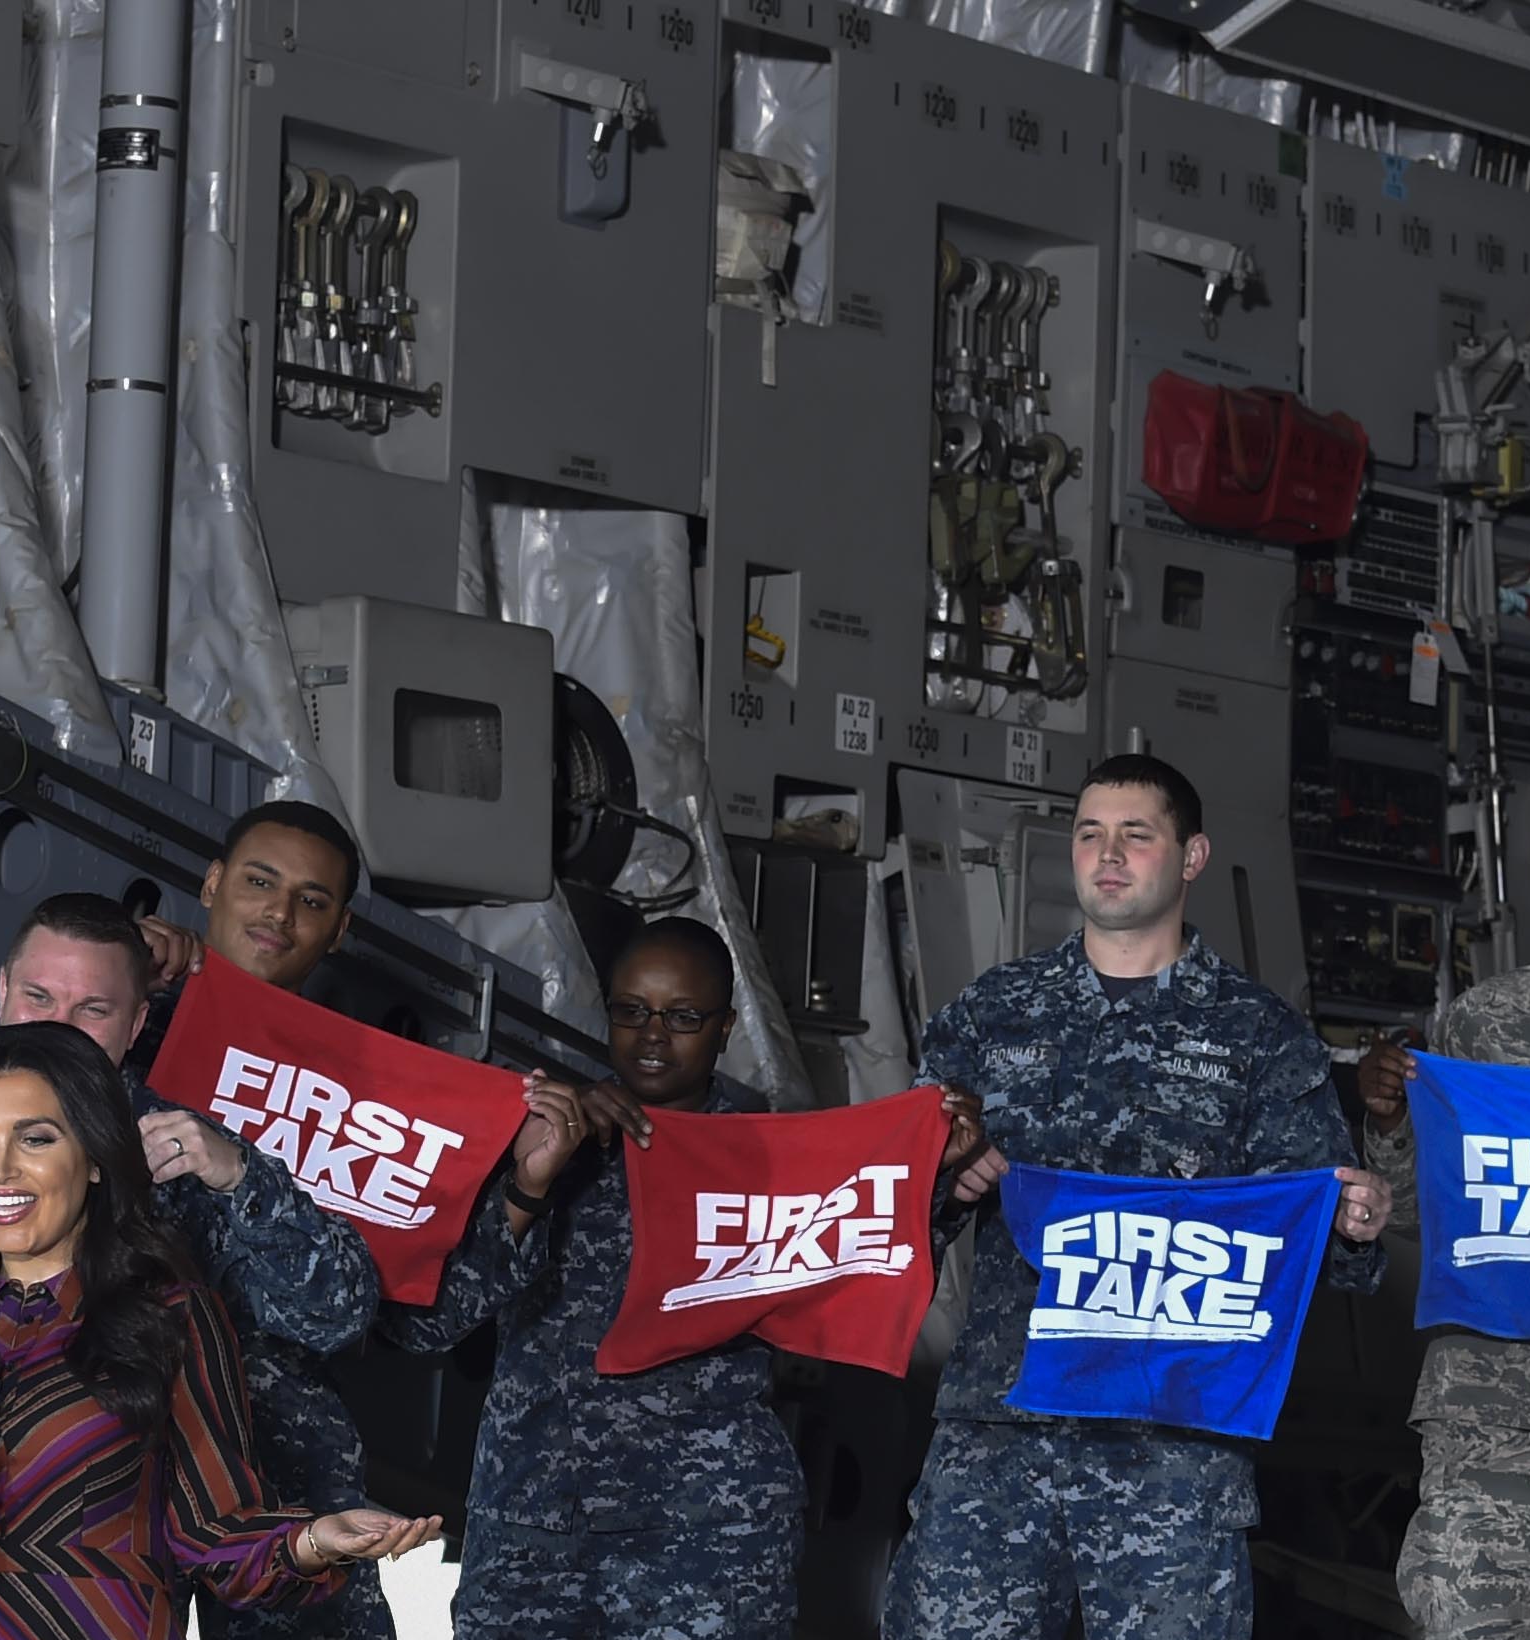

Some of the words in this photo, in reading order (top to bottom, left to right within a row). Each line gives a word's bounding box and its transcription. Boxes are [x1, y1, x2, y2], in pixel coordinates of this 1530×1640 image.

[660, 14, 693, 46] 1260
[838, 13, 871, 43] 1240
[925, 92, 957, 122] 1230
[1008, 116, 1039, 146] 1220
[730, 691, 764, 720] 1250
[842, 698, 855, 716] AD
[858, 701, 870, 719] 22
[139, 719, 154, 742] 23
[842, 729, 868, 751] 1238
[907, 724, 939, 752] 1230
[1012, 731, 1024, 747] AD
[1026, 732, 1038, 750] 21
[1012, 761, 1035, 783] 1218
[1197, 1060, 1230, 1080] NAVY
[214, 1045, 465, 1175] FIRST
[209, 1098, 431, 1220] TAKE
[695, 1164, 909, 1243] FIRST
[695, 1218, 894, 1281] TAKE
[1042, 1211, 1284, 1284] FIRST
[1042, 1254, 1262, 1329] TAKE
